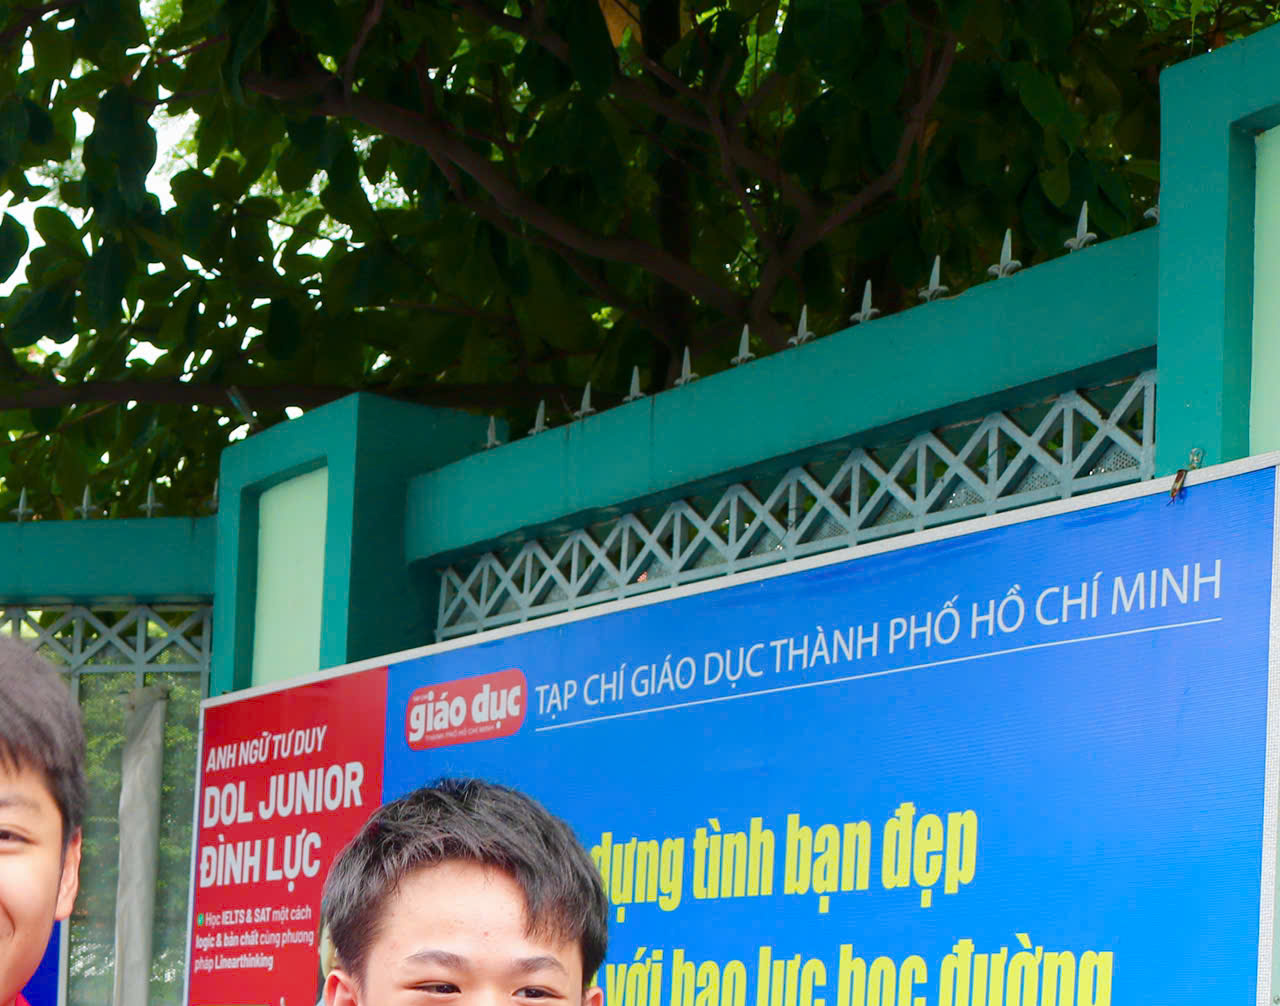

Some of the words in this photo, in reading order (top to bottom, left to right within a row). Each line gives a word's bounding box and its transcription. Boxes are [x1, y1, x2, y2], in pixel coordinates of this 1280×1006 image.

[536, 681, 577, 719] TẠP
[584, 663, 625, 705] CHÍ
[632, 656, 696, 697] GIÁO
[705, 644, 763, 689] DỤC
[769, 622, 878, 673] THÀNH
[889, 595, 960, 653] PHỐ
[971, 584, 1024, 639] HỒ
[1035, 572, 1102, 626] CHÍ
[1111, 559, 1221, 614] MINH
[409, 691, 467, 742] giáo
[471, 683, 521, 729] dục
[206, 744, 236, 772] ANH
[239, 731, 271, 766] NGỮ
[273, 729, 295, 760] TƯ
[294, 725, 328, 756] DUY
[203, 781, 253, 828] DOL
[259, 762, 364, 820] JUNIOR
[200, 834, 262, 888] ĐÌNH
[266, 828, 321, 892] LỰC
[693, 818, 775, 899] tình
[784, 814, 871, 913] bạn
[882, 802, 977, 908] đẹp
[254, 907, 272, 922] SAT
